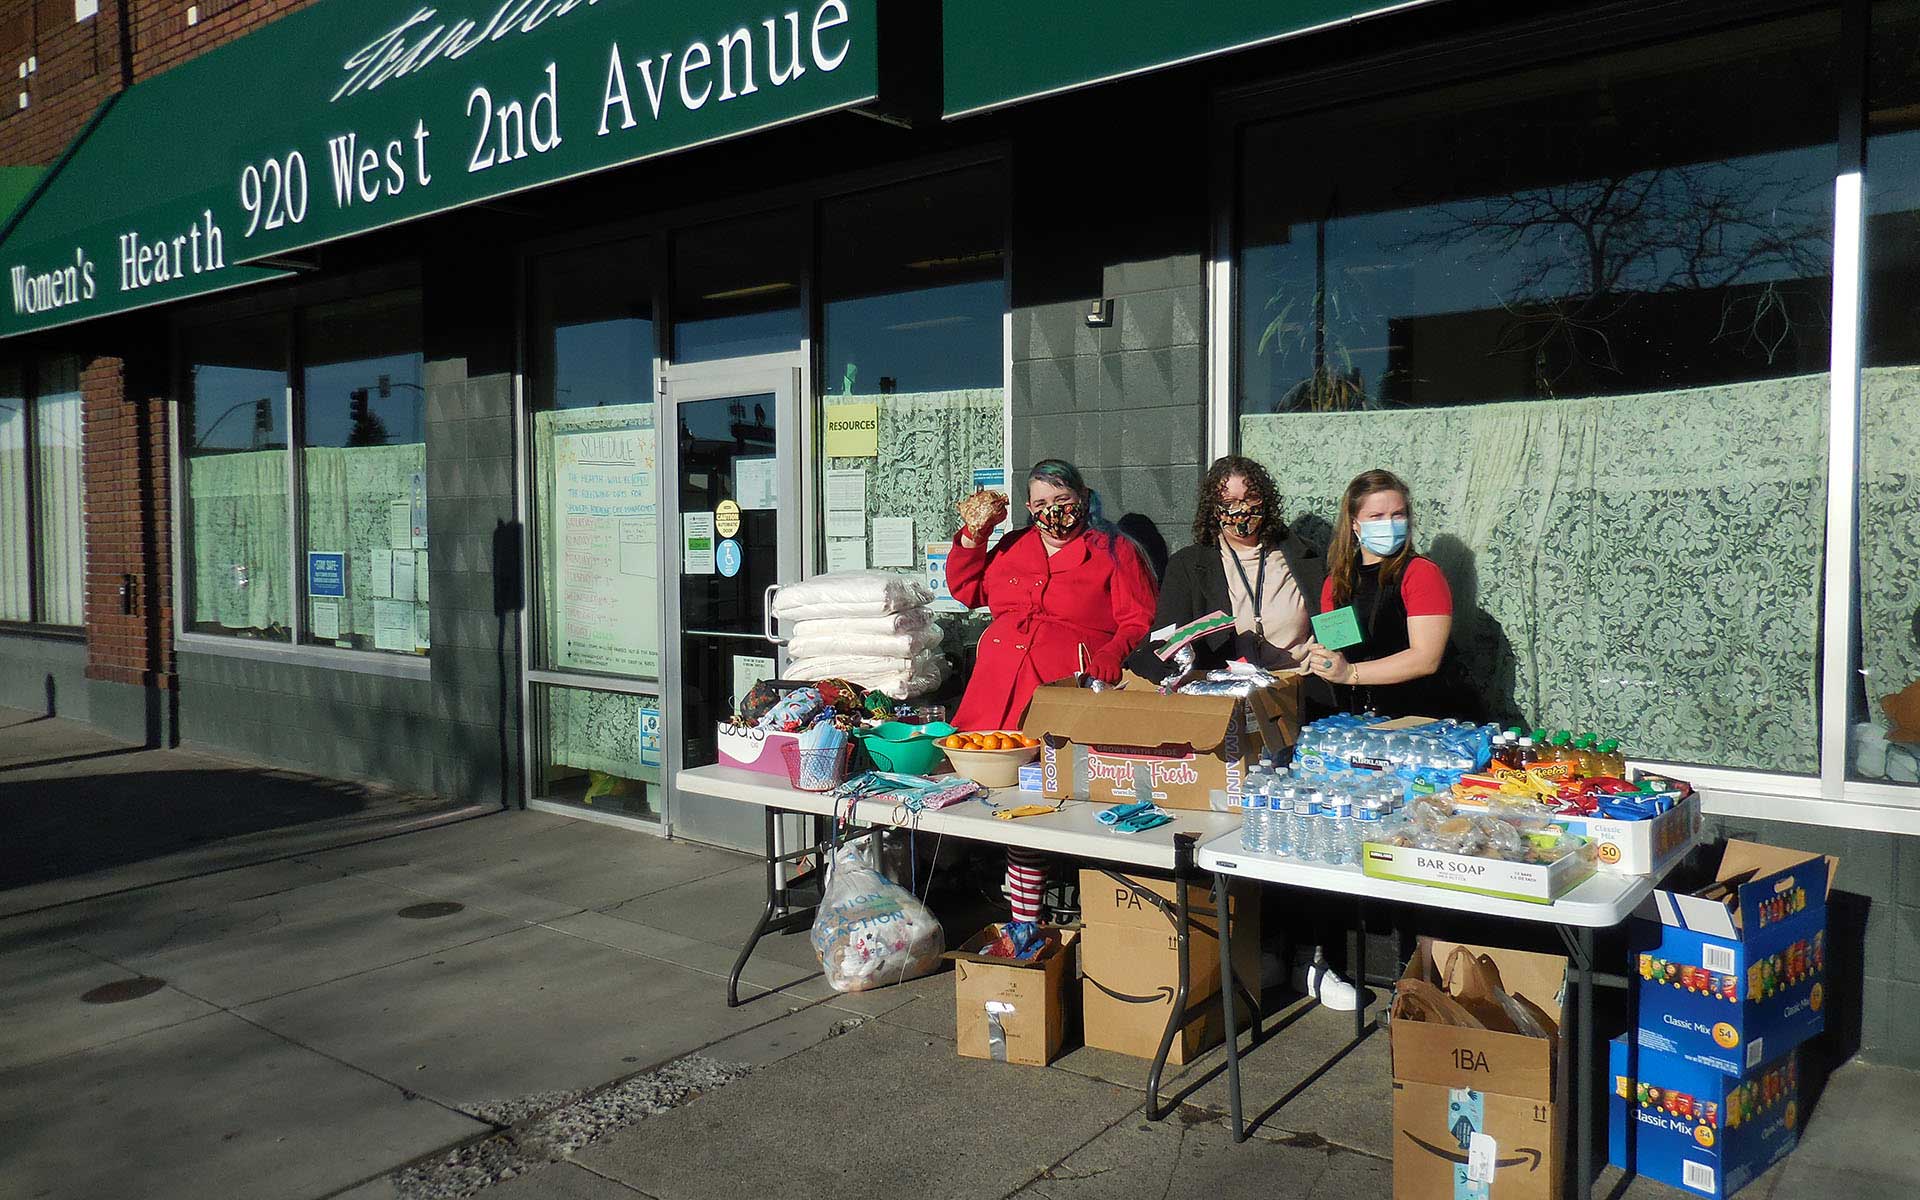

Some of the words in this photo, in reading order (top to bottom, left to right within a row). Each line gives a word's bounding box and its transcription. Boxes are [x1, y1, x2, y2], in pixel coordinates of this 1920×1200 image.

[240, 149, 307, 238] 920
[327, 118, 432, 209] West
[466, 62, 562, 174] 2nd
[598, 0, 851, 138] Avenue
[10, 247, 96, 315] Women's
[119, 209, 225, 291] Hearth
[828, 420, 876, 431] RESOURCES
[1148, 760, 1197, 787] Fresh
[1594, 824, 1623, 834] Classic
[1601, 832, 1615, 840] Mix
[1602, 846, 1617, 857] 50
[1417, 857, 1445, 871] BAR
[1449, 861, 1486, 876] SOAP
[1663, 1014, 1693, 1030] Classic
[1694, 1023, 1711, 1036] Mix
[1719, 1028, 1732, 1039] 54
[1451, 1048, 1490, 1073] 1BA
[1631, 1108, 1668, 1129] Classic
[1669, 1119, 1693, 1136] Mix
[1700, 1129, 1711, 1138] 54
